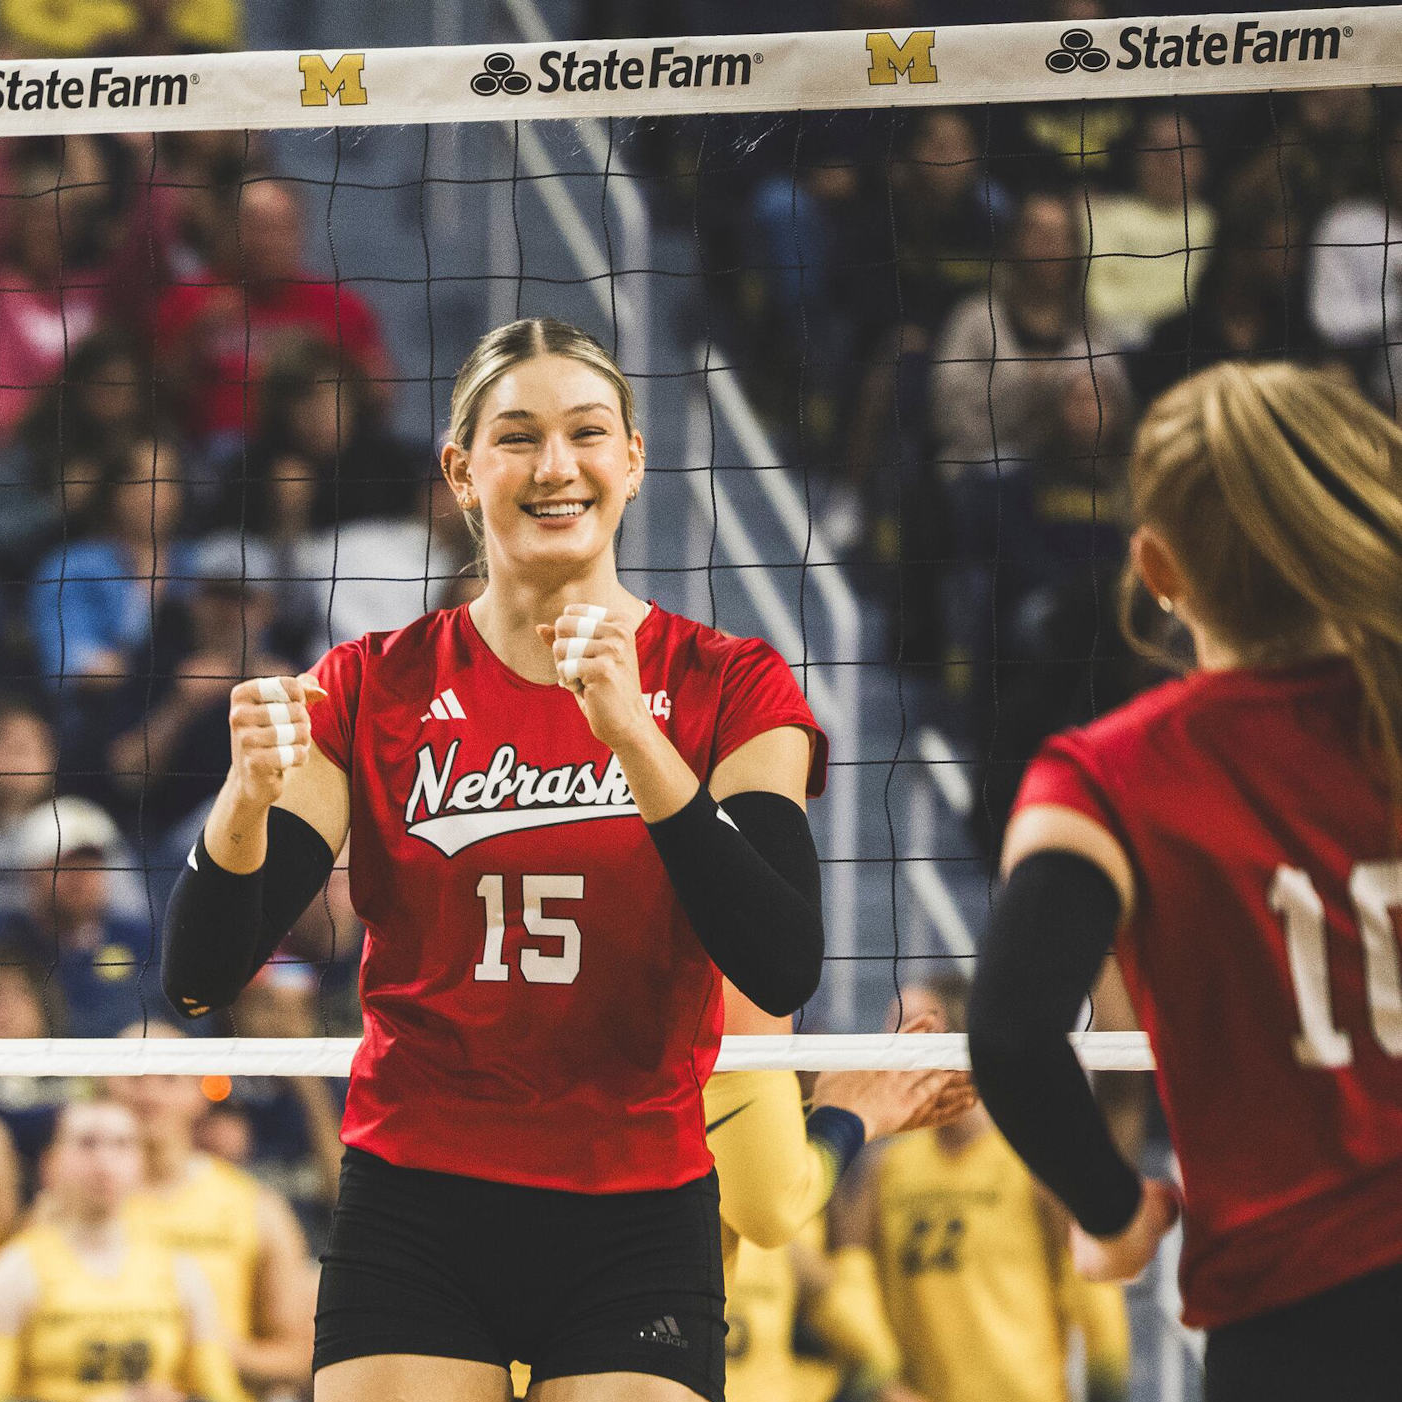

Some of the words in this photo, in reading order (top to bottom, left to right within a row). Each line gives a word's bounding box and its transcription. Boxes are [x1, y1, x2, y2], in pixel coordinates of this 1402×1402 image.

[298, 53, 367, 107] M
[865, 30, 937, 85] M
[404, 737, 638, 824] Nebrask
[474, 873, 585, 985] 15
